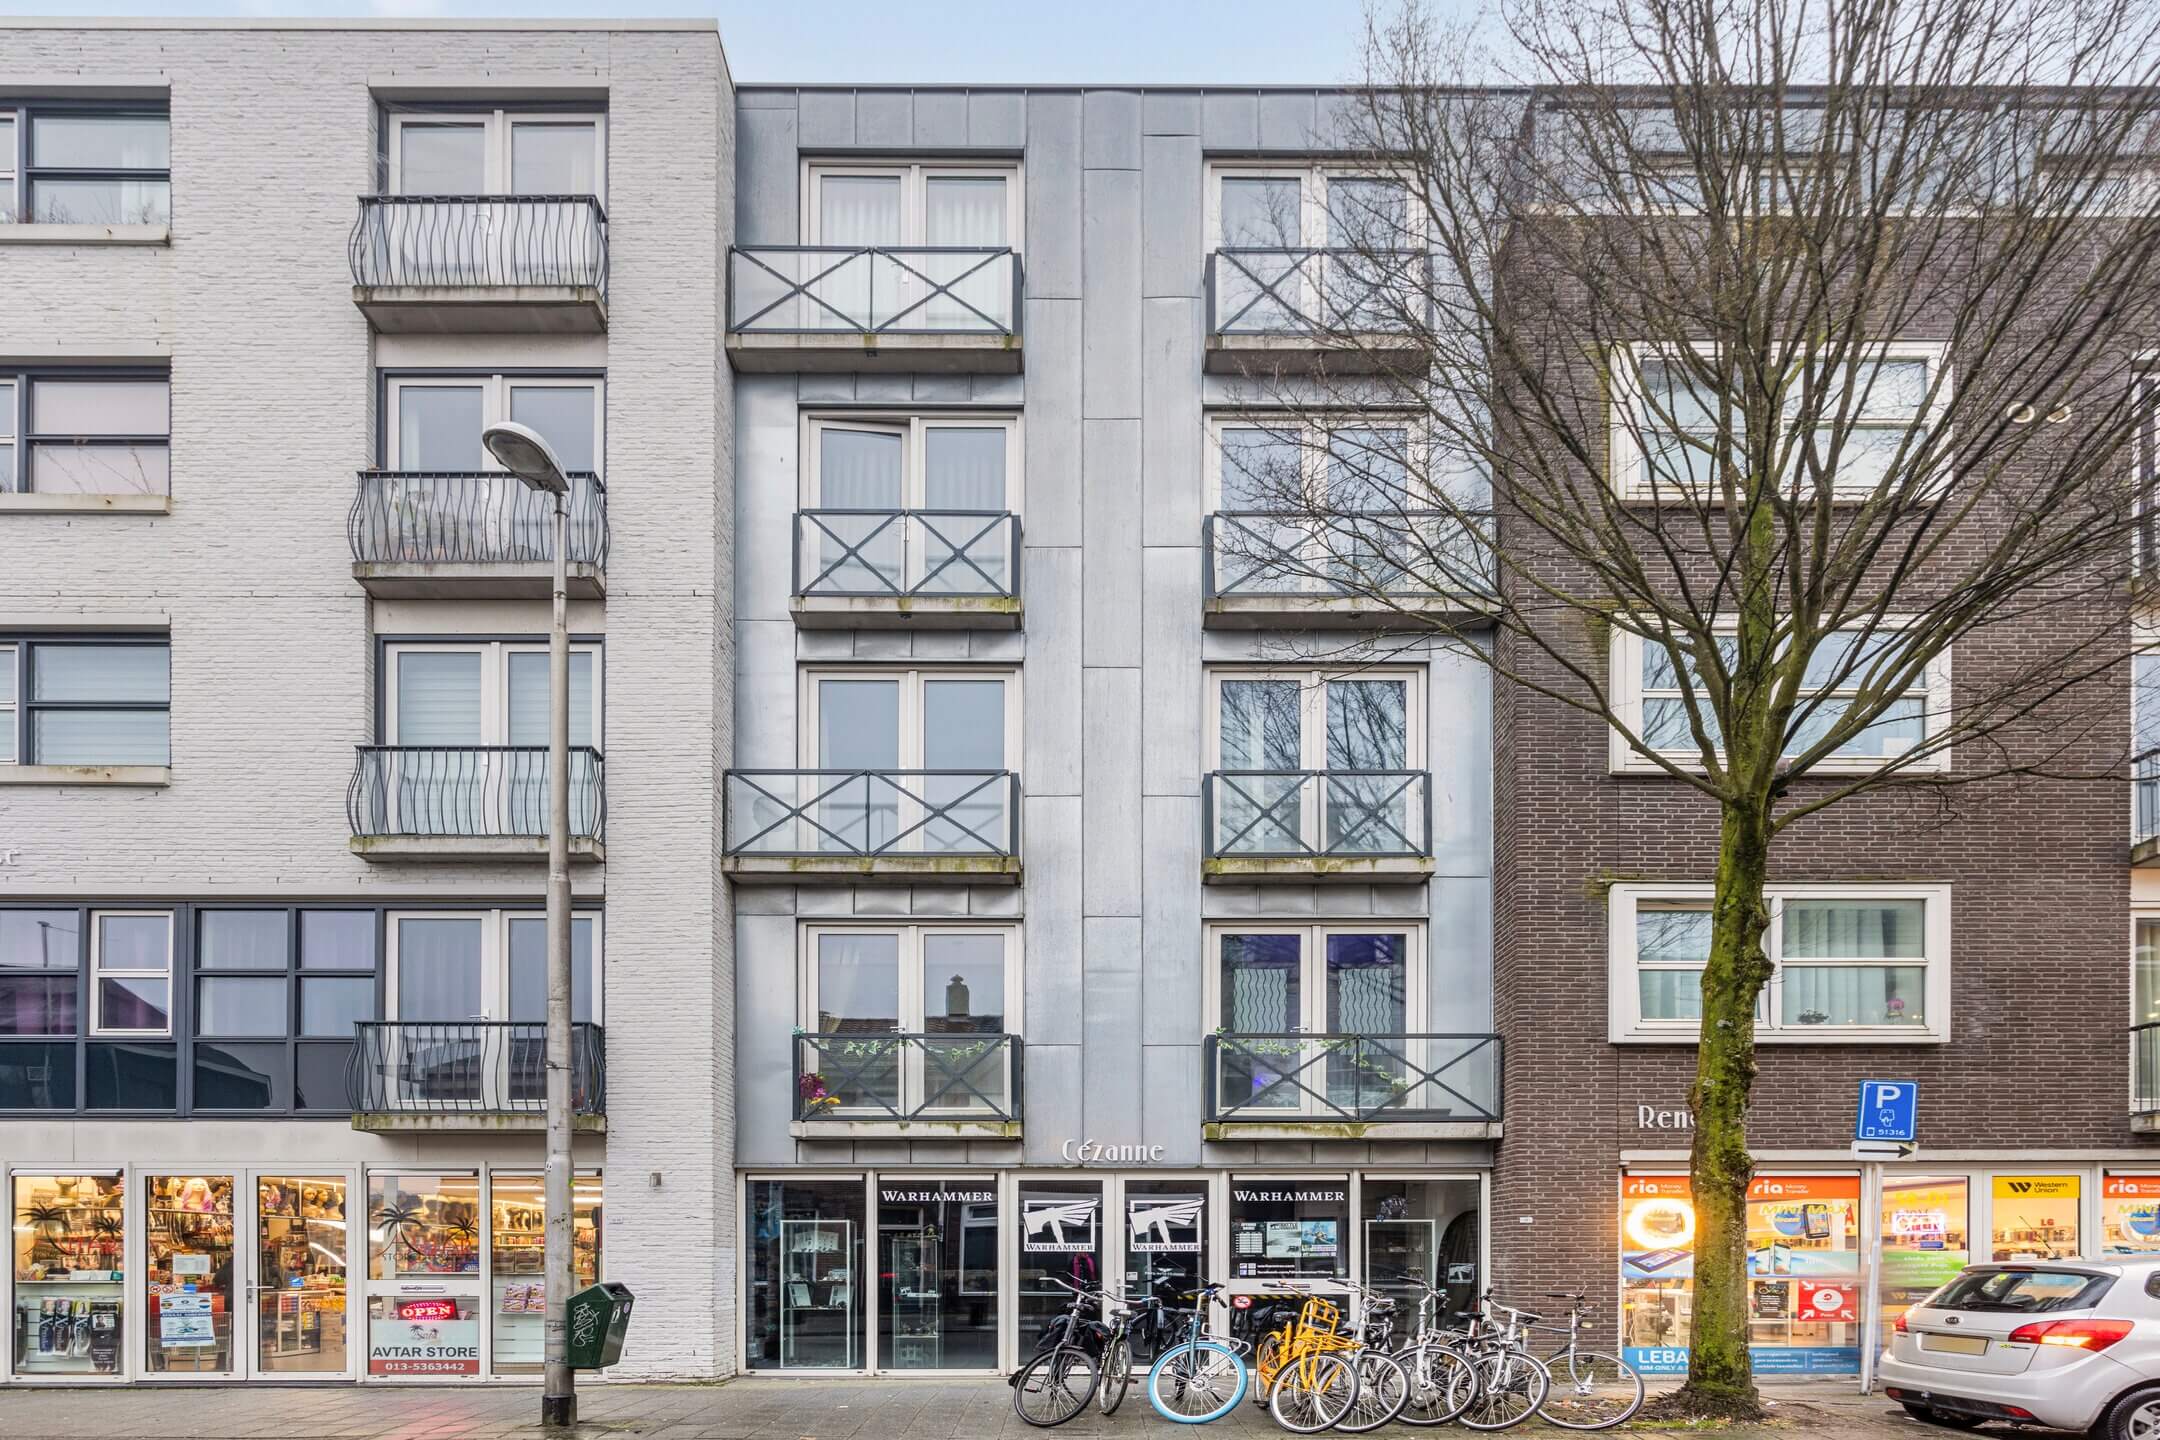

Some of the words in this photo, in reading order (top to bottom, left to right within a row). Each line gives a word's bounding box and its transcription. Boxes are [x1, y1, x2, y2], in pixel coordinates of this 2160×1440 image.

[1876, 1085, 1901, 1109] P
[1062, 1139, 1165, 1162] Cézanne
[1629, 1180, 1658, 1194] ria
[1753, 1179, 1783, 1194] ria
[2109, 1179, 2138, 1194] ria
[881, 1190, 993, 1201] WARHAMMER
[1233, 1190, 1345, 1201] WARHAMMER
[1026, 1243, 1093, 1251] WARHAMMER
[1132, 1243, 1200, 1251] WARHAMMER
[402, 1305, 451, 1318] OPEN
[372, 1347, 421, 1357] AVTAR
[427, 1347, 477, 1357] STORE
[385, 1363, 465, 1371] 013-5363442
